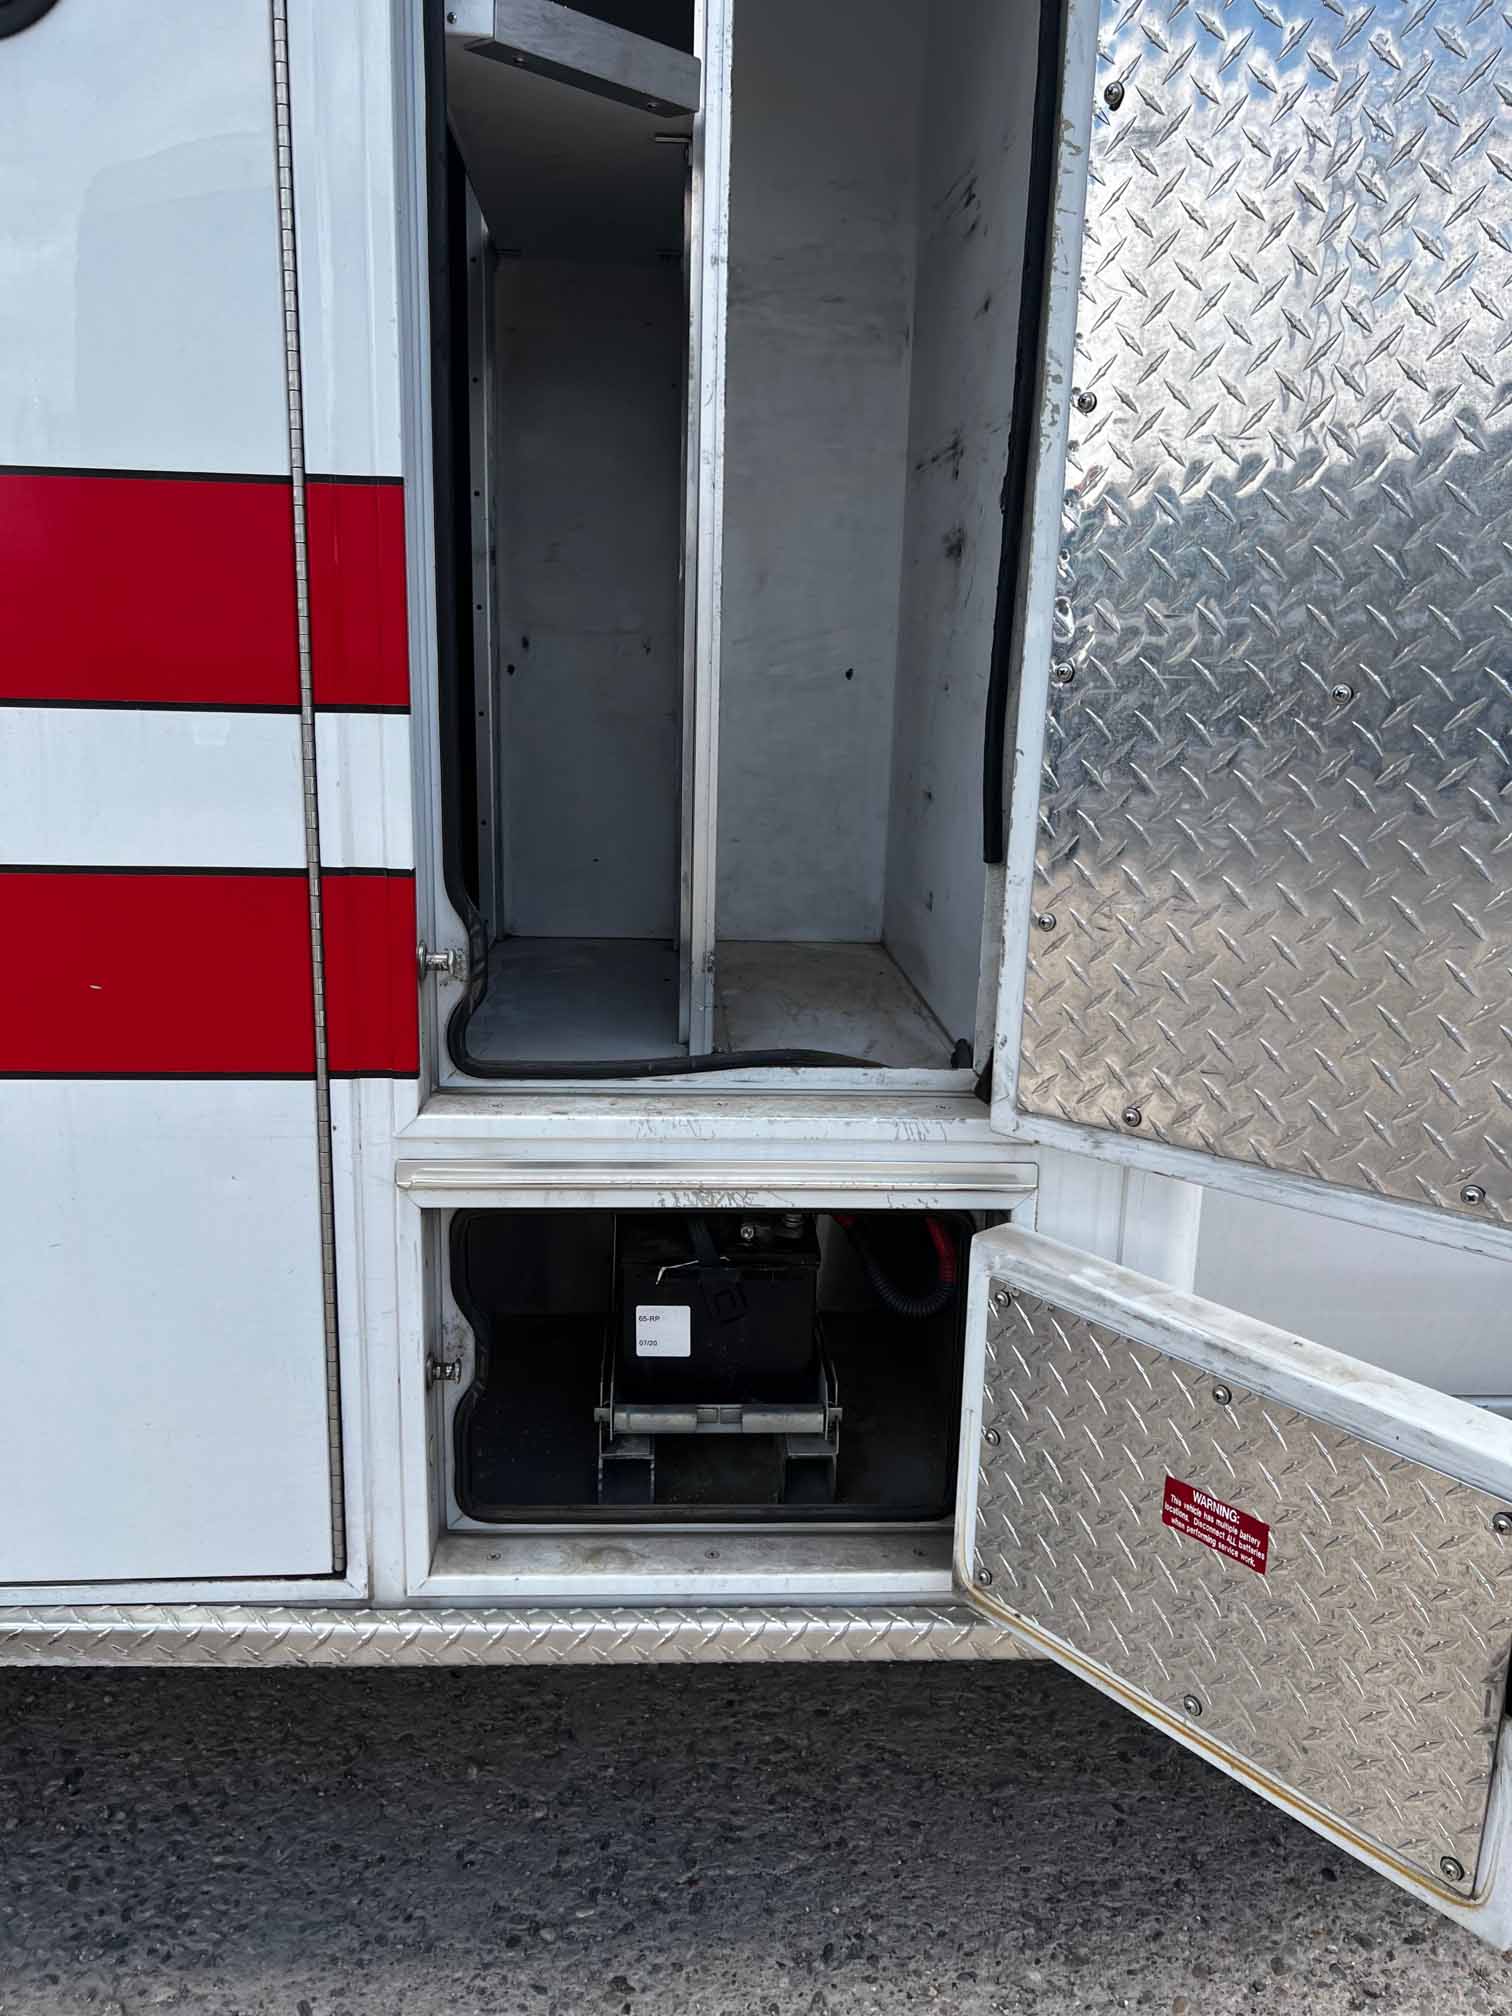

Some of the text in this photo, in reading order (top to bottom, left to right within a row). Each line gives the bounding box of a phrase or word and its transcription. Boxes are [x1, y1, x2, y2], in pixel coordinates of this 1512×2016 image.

[1164, 1501, 1265, 1560] locations. Disconnect ALL batteries
[1170, 1494, 1260, 1548] This vehicle has multiple battery
[1193, 1490, 1240, 1524] WARNING:
[1171, 1517, 1256, 1568] when performing service work.
